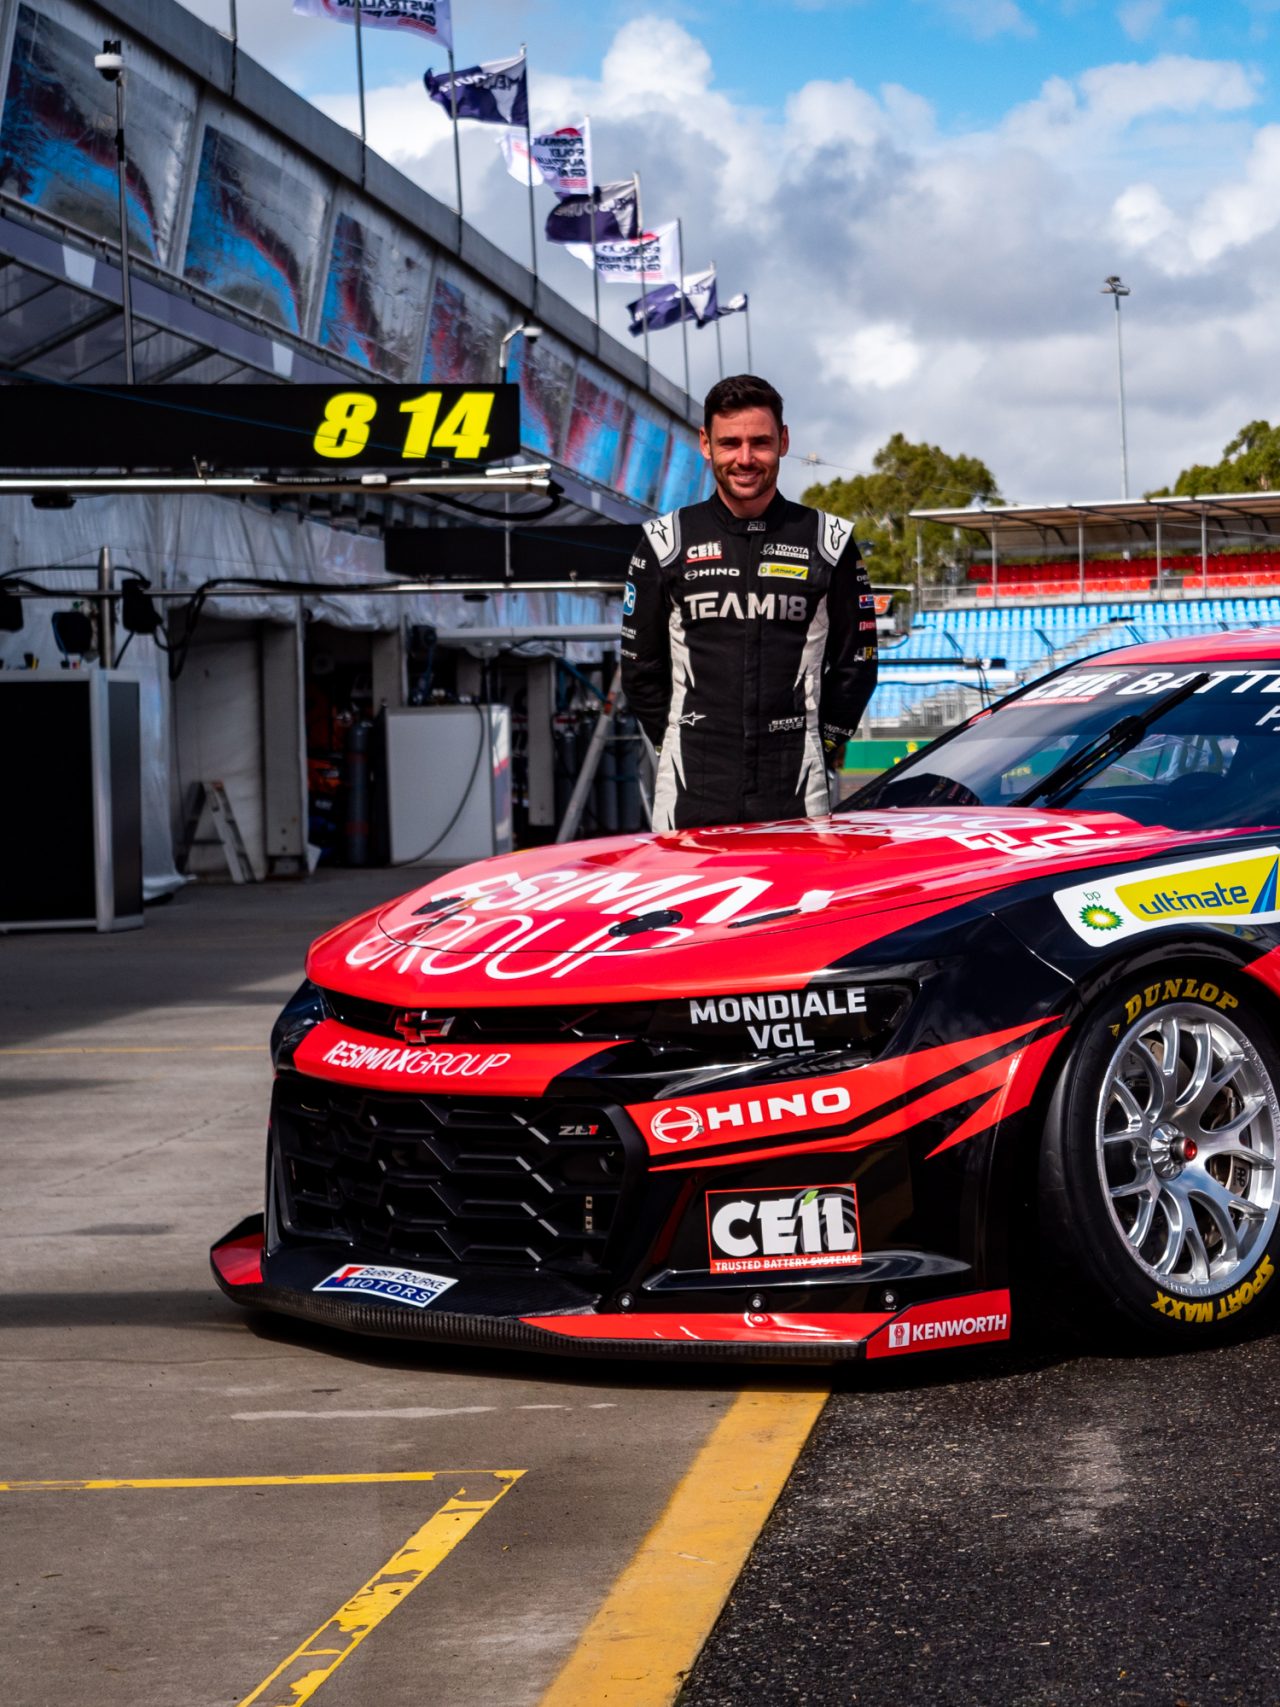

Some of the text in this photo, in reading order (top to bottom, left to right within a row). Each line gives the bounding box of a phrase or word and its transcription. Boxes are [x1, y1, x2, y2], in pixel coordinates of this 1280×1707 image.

[313, 391, 495, 459] 8 14
[775, 543, 809, 555] TOYOTA
[699, 568, 741, 577] HINO
[1083, 891, 1101, 902] bp
[1138, 881, 1250, 915] ultimate
[345, 914, 695, 981] GROUP
[690, 986, 868, 1025] MONDIALE
[1125, 978, 1240, 1026] DUNLOP
[747, 1023, 815, 1050] VGL
[706, 1086, 852, 1131] HINO
[558, 1124, 599, 1136] ZL1
[711, 1192, 857, 1258] CEIL
[715, 1254, 858, 1271] TRUSTED BATTERY SYSTEMS
[344, 1278, 431, 1302] MOTORS
[1216, 1254, 1275, 1321] SPORT
[1150, 1290, 1214, 1323] MAXX
[912, 1313, 1008, 1342] KENWORTH
